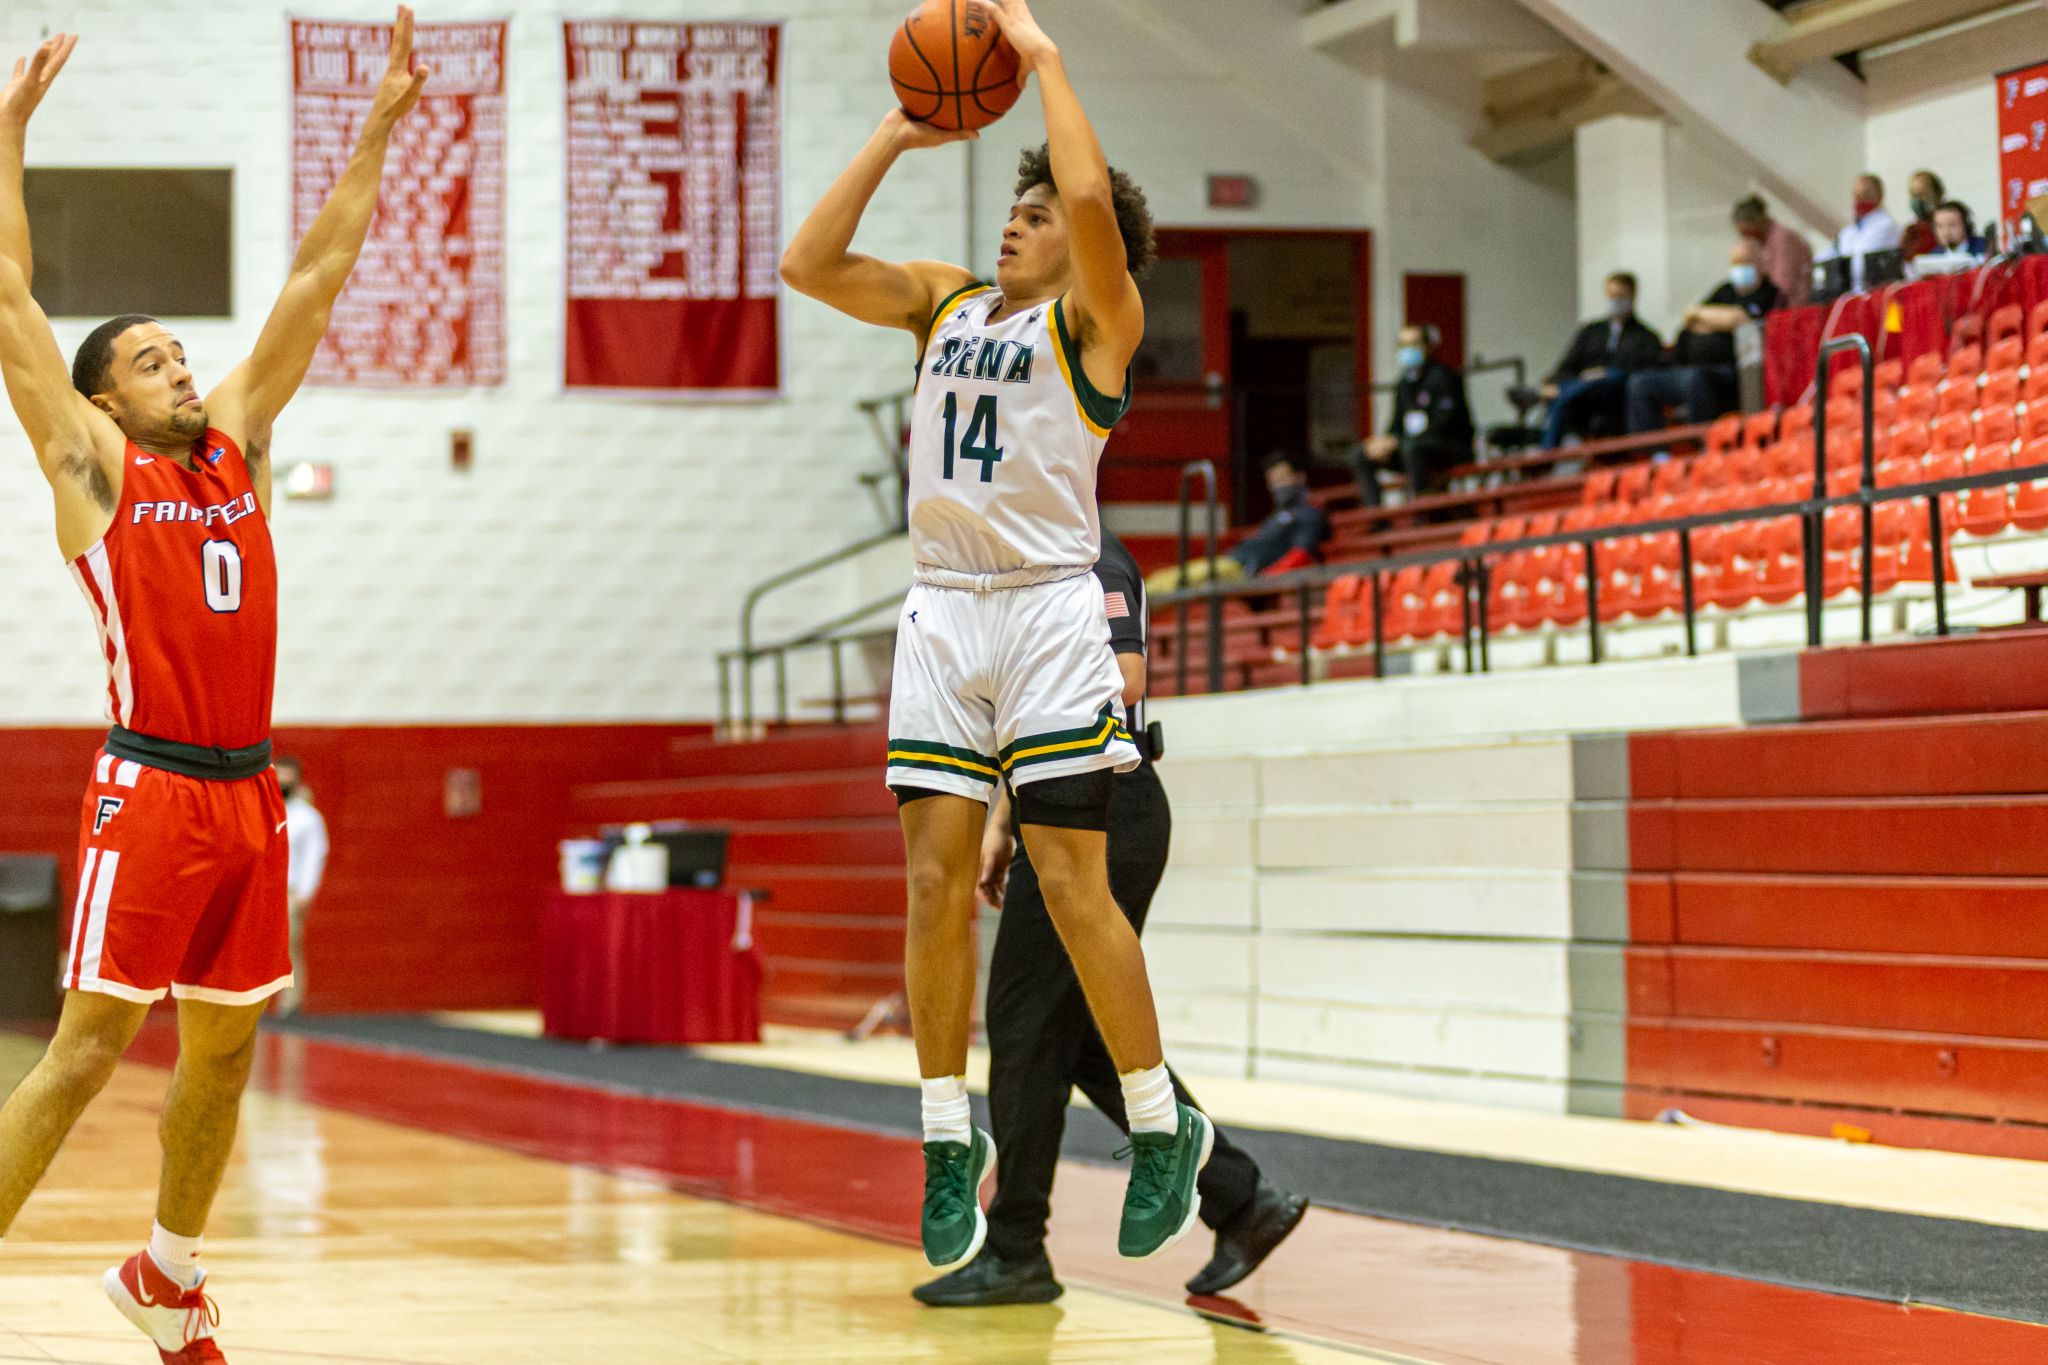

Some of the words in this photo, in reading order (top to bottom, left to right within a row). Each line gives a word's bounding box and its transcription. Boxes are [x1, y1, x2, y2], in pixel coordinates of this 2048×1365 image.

[931, 336, 1035, 383] SIENA
[942, 391, 1004, 483] 14
[201, 537, 243, 613] 0
[93, 795, 125, 836] F
